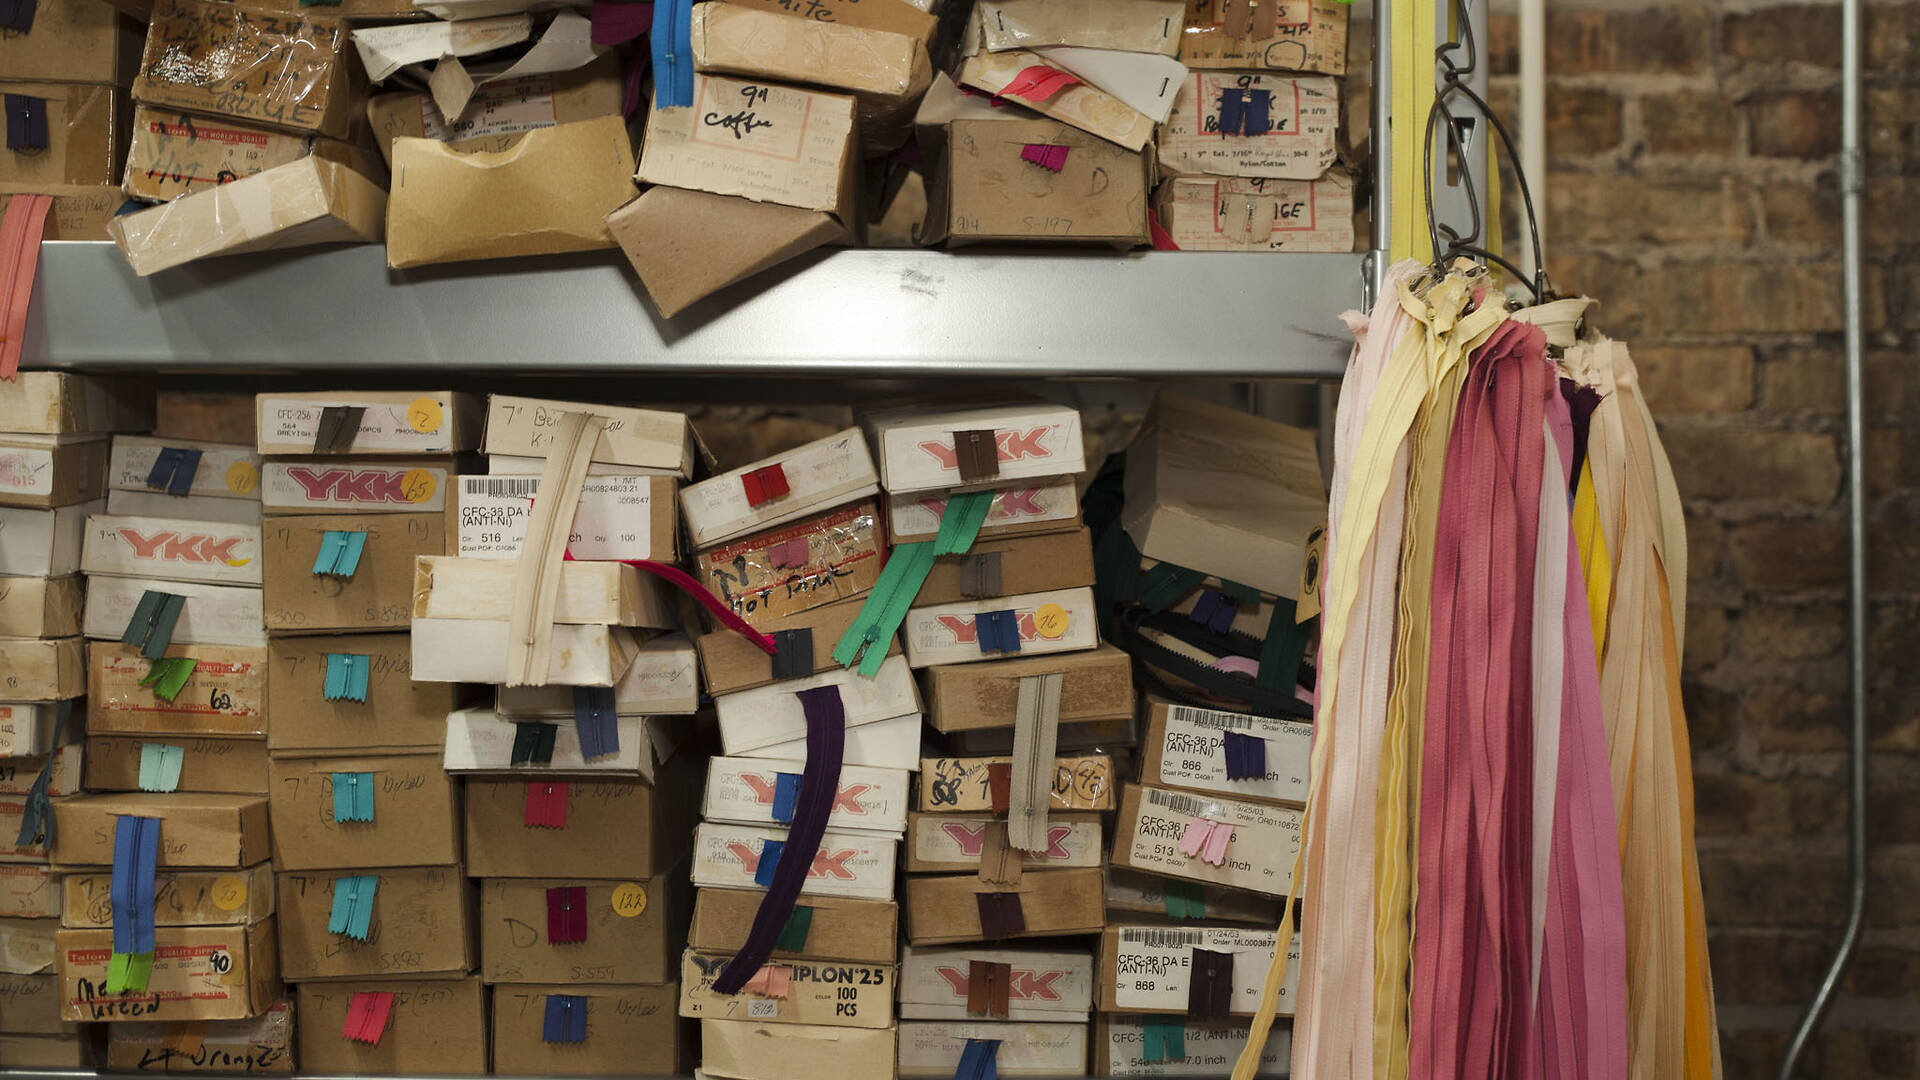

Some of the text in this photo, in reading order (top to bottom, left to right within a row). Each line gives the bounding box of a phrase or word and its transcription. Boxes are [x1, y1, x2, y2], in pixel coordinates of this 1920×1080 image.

[741, 86, 769, 109] 9"
[1274, 202, 1304, 220] IGE
[462, 506, 524, 517] CFC-36 DA
[116, 527, 243, 563] YKK
[481, 532, 502, 543] 516
[568, 532, 582, 543] ch
[620, 534, 636, 542] 100
[1166, 732, 1207, 747] CFC-36
[1182, 760, 1202, 771] 866
[1265, 771, 1279, 782] ch
[737, 771, 872, 816] YK
[1140, 815, 1181, 832] CFC-36
[940, 822, 1071, 860] YK
[725, 842, 857, 879] YK
[1154, 844, 1175, 857] 513
[1228, 859, 1251, 872] inch
[617, 892, 643, 910] 122
[71, 952, 107, 961] Talon
[1118, 954, 1190, 967] CFC-36 DA E
[1135, 980, 1155, 991] 868
[836, 987, 858, 1001] 100
[836, 1002, 858, 1017] PCS
[1112, 1033, 1145, 1044] CFC-3
[1204, 1055, 1227, 1065] inch
